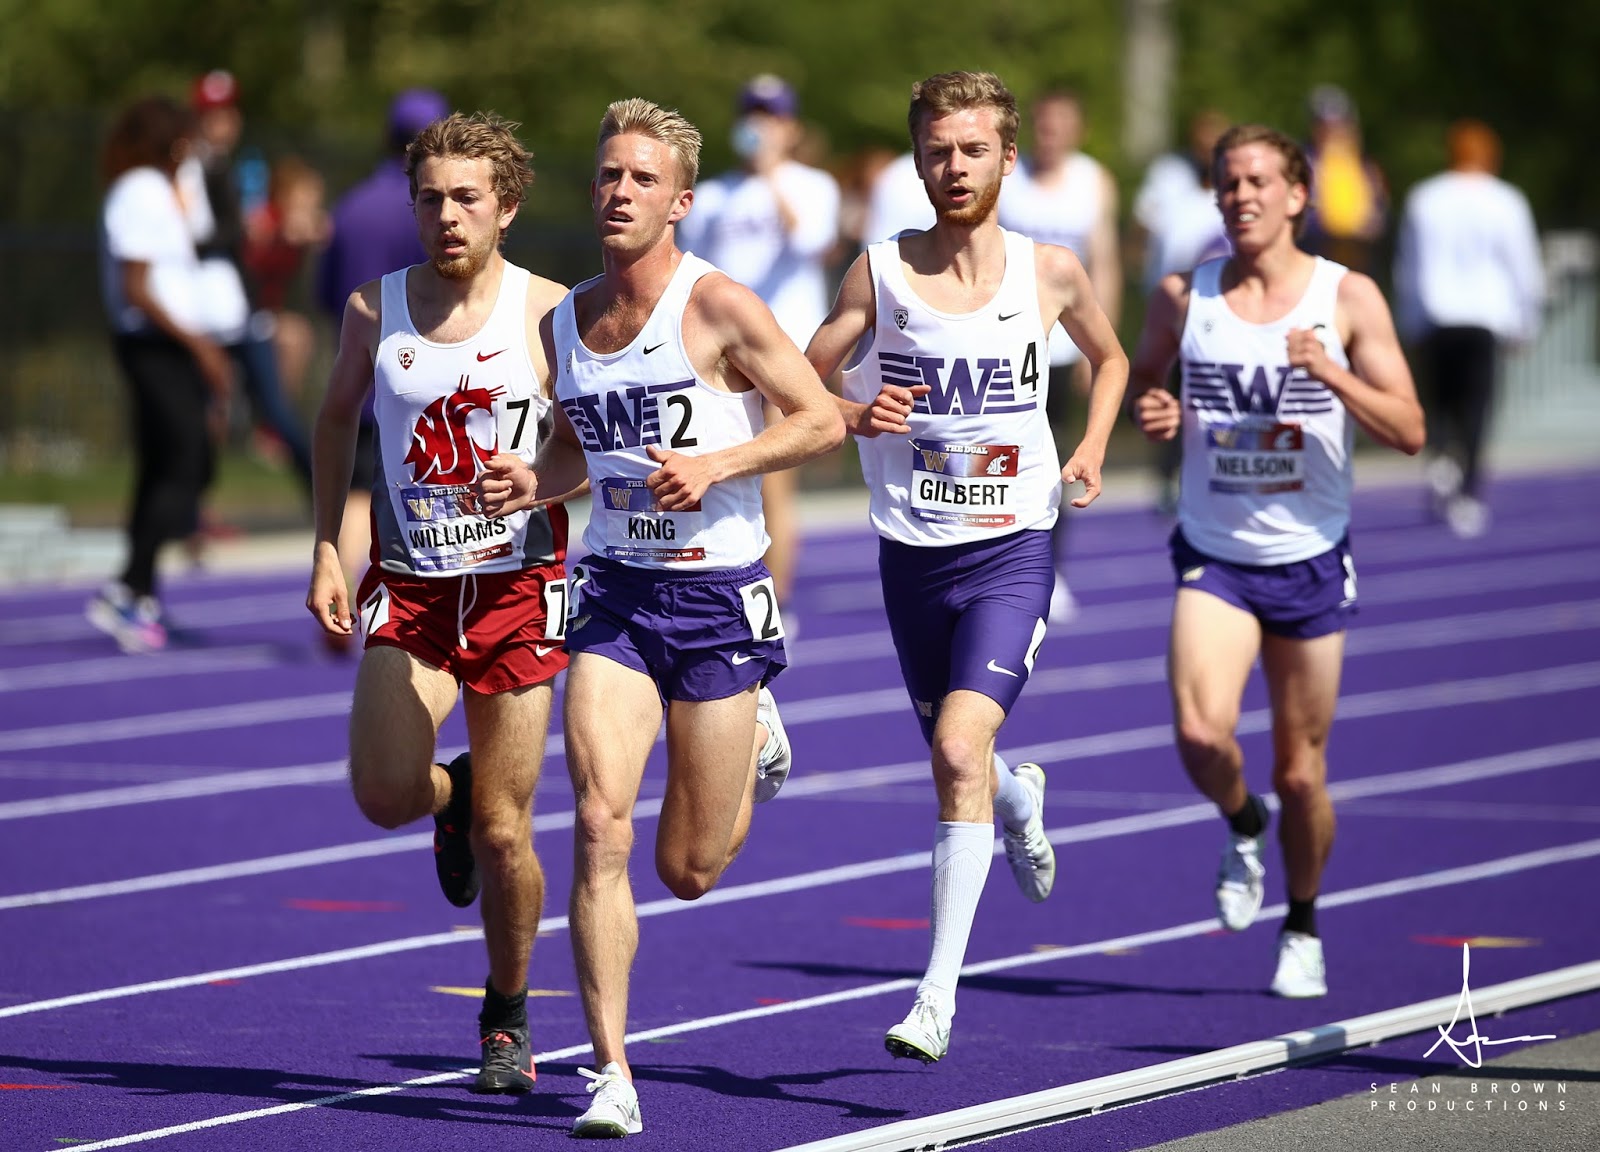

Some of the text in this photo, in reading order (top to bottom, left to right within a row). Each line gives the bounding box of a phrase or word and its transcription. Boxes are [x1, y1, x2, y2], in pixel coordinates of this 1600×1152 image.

[915, 358, 1000, 415] W
[1020, 341, 1039, 392] 4
[506, 398, 530, 450] 7
[577, 386, 647, 452] W
[667, 394, 697, 448] 2
[945, 444, 988, 455] THE DUAL
[1216, 456, 1295, 476] NELSON
[429, 486, 470, 497] THE DUAL
[920, 479, 1009, 506] GILBERT
[409, 517, 506, 549] WILLIAMS
[628, 517, 675, 540] KING
[366, 590, 383, 636] 7
[550, 583, 565, 637] 7
[751, 584, 779, 639] 2
